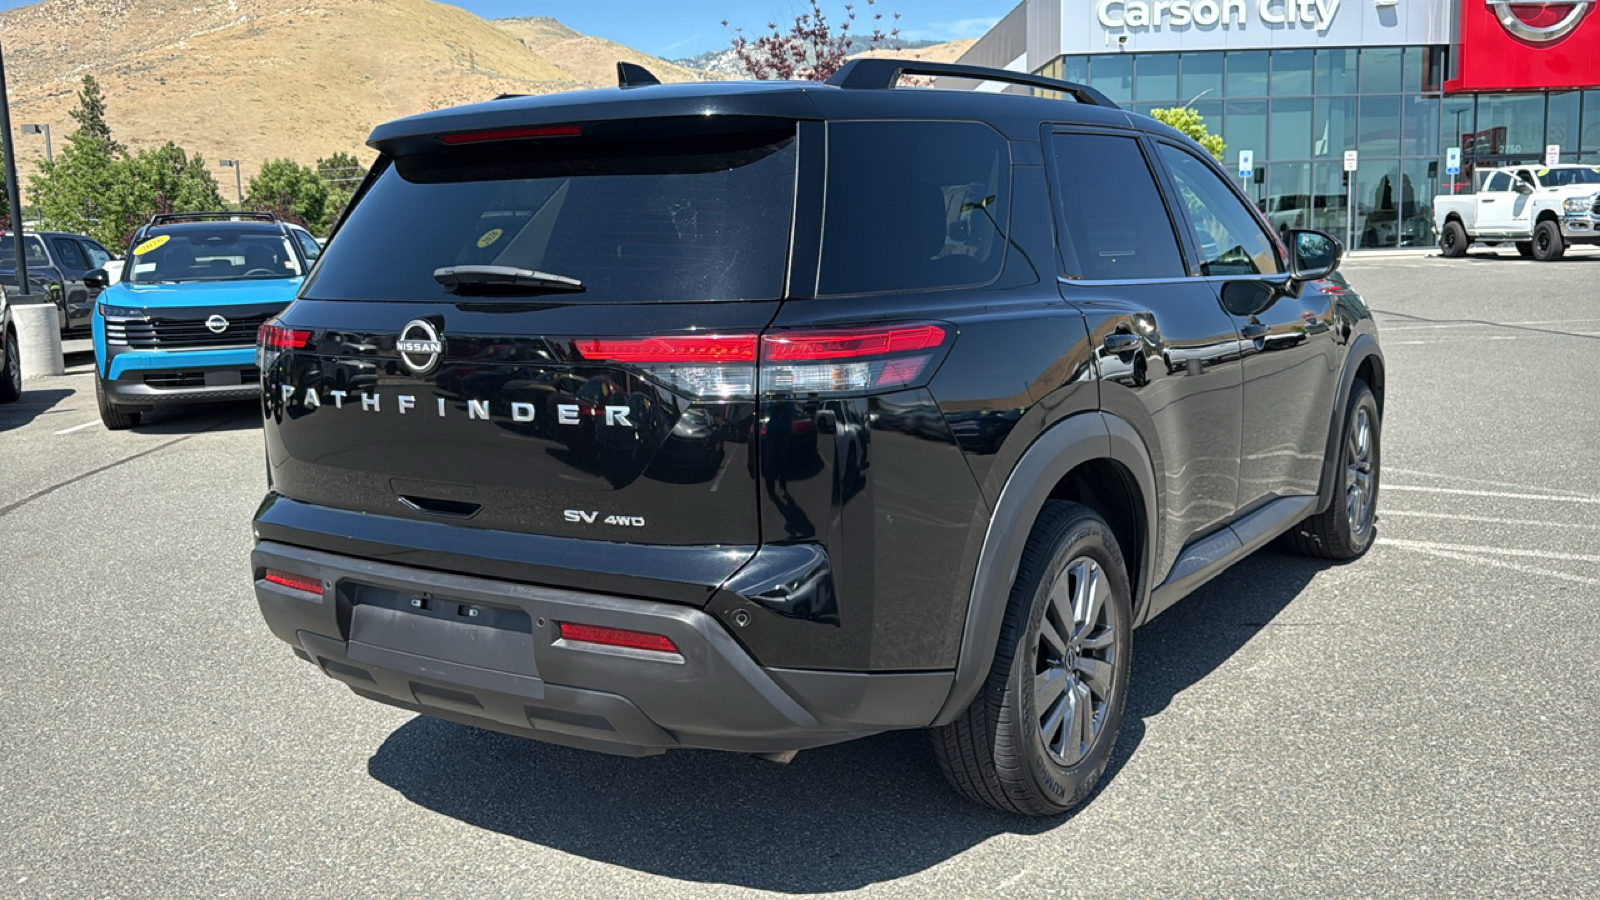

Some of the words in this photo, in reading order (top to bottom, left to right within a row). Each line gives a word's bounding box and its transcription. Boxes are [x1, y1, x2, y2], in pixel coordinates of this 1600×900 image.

[1097, 0, 1247, 28] Carson
[1259, 0, 1341, 32] City
[1498, 144, 1522, 154] 2750
[396, 341, 440, 352] NISSAN
[281, 384, 633, 427] PATHFINDER
[563, 509, 599, 524] SV
[604, 514, 645, 527] 4WD
